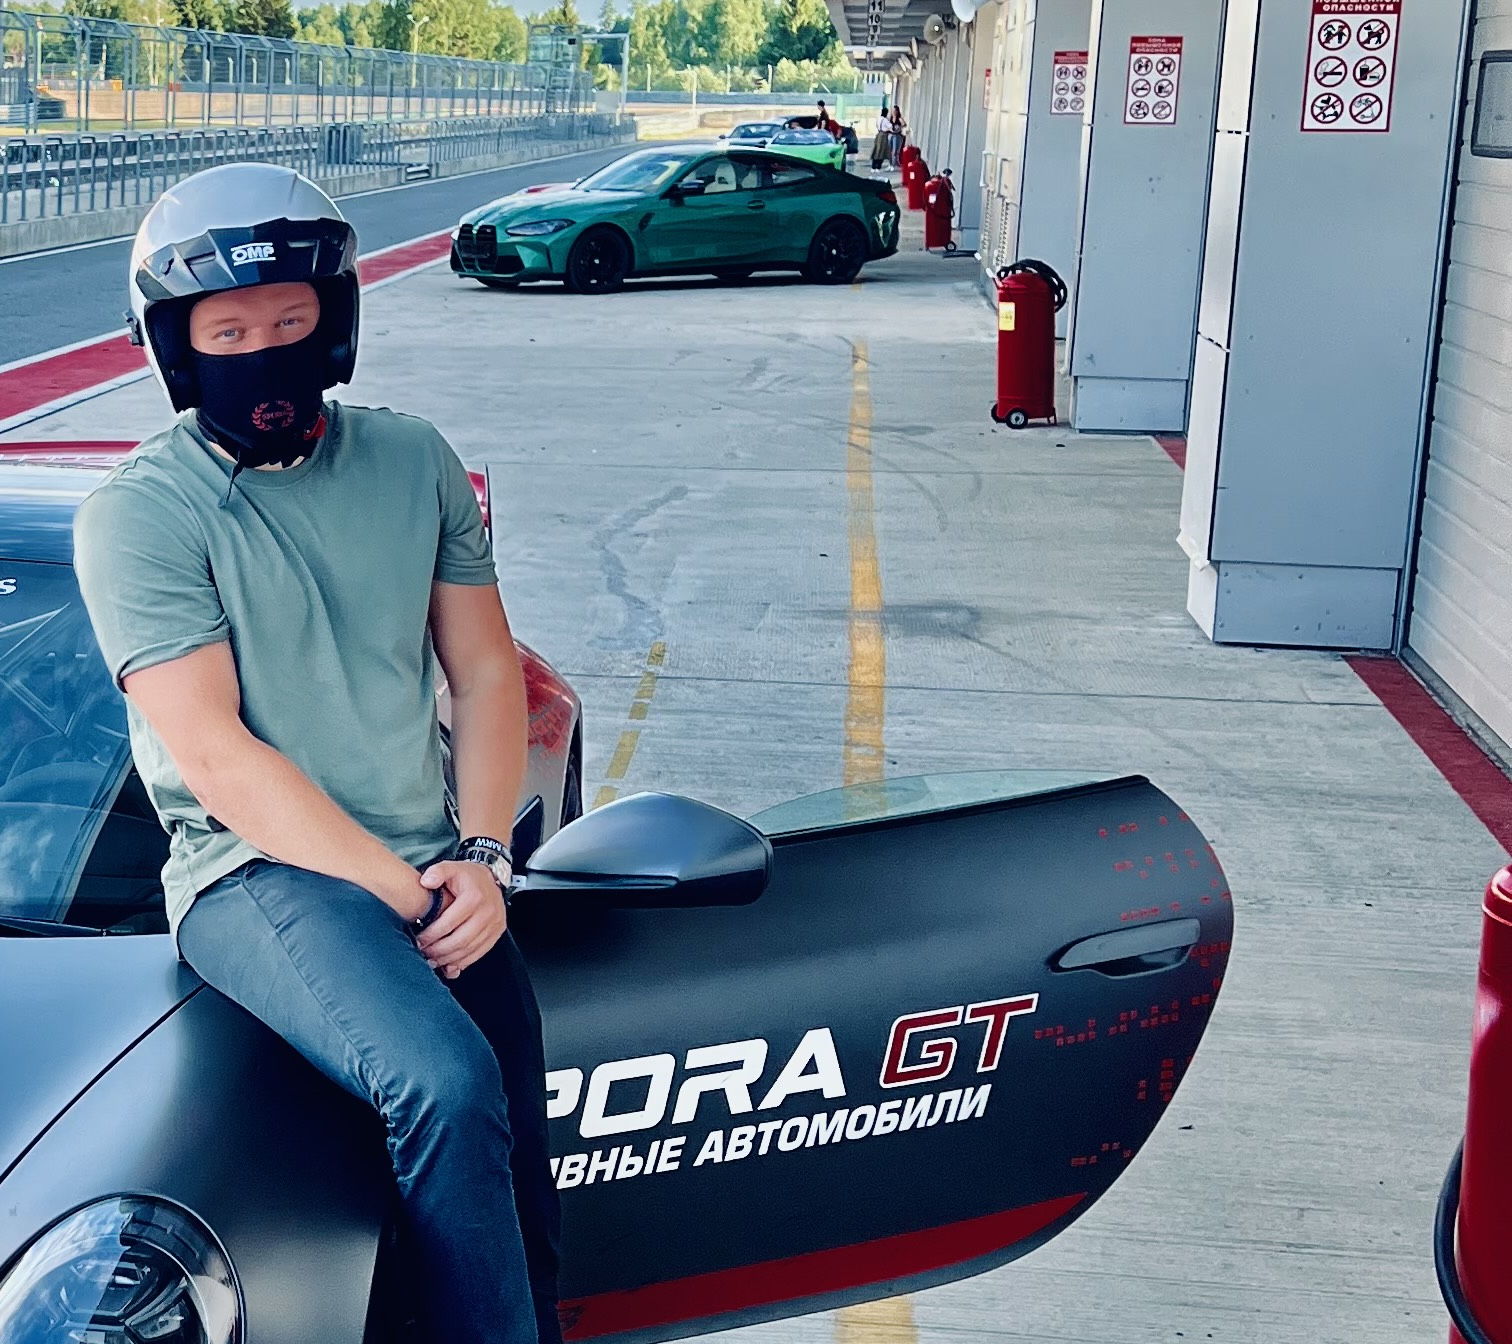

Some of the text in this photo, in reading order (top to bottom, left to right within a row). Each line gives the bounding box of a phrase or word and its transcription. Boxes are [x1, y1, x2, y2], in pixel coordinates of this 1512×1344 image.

[870, 0, 883, 11] 11
[1322, 4, 1394, 12] ОПАСНОСТИ
[869, 14, 881, 24] 10
[231, 244, 275, 263] OMP
[879, 992, 1039, 1090] GT
[692, 1083, 992, 1168] АВТОМОБИЛИ
